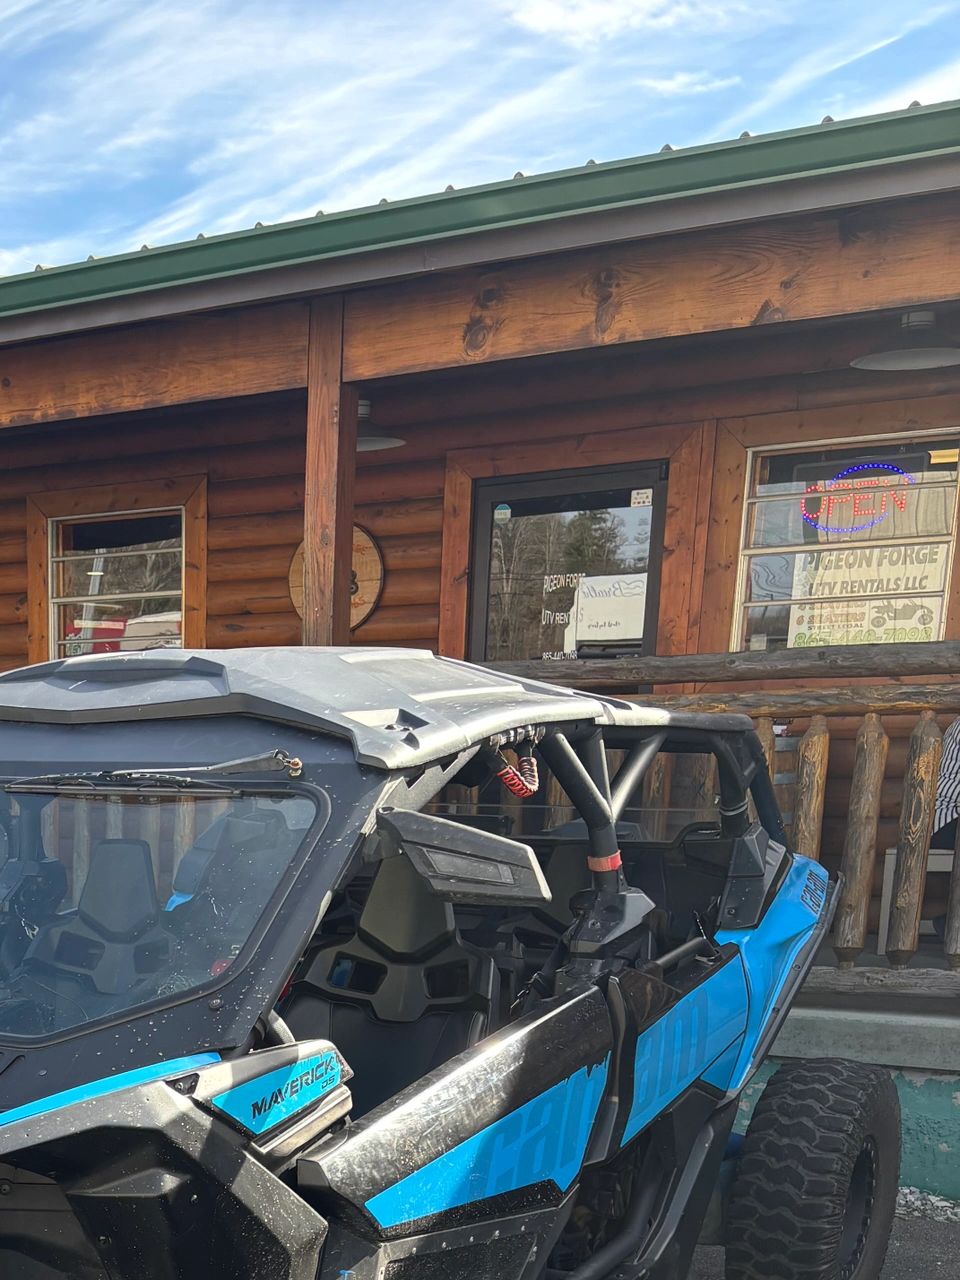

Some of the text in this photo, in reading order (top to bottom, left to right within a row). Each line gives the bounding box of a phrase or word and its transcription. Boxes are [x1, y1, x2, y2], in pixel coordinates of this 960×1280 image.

[800, 478, 908, 518] OPEN
[802, 547, 938, 571] PIGEON FORGE
[543, 574, 565, 595] PIGEON
[809, 575, 928, 597] UTV RENTALS LLC
[542, 608, 554, 625] UTV
[251, 1056, 336, 1119] MAVERICK
